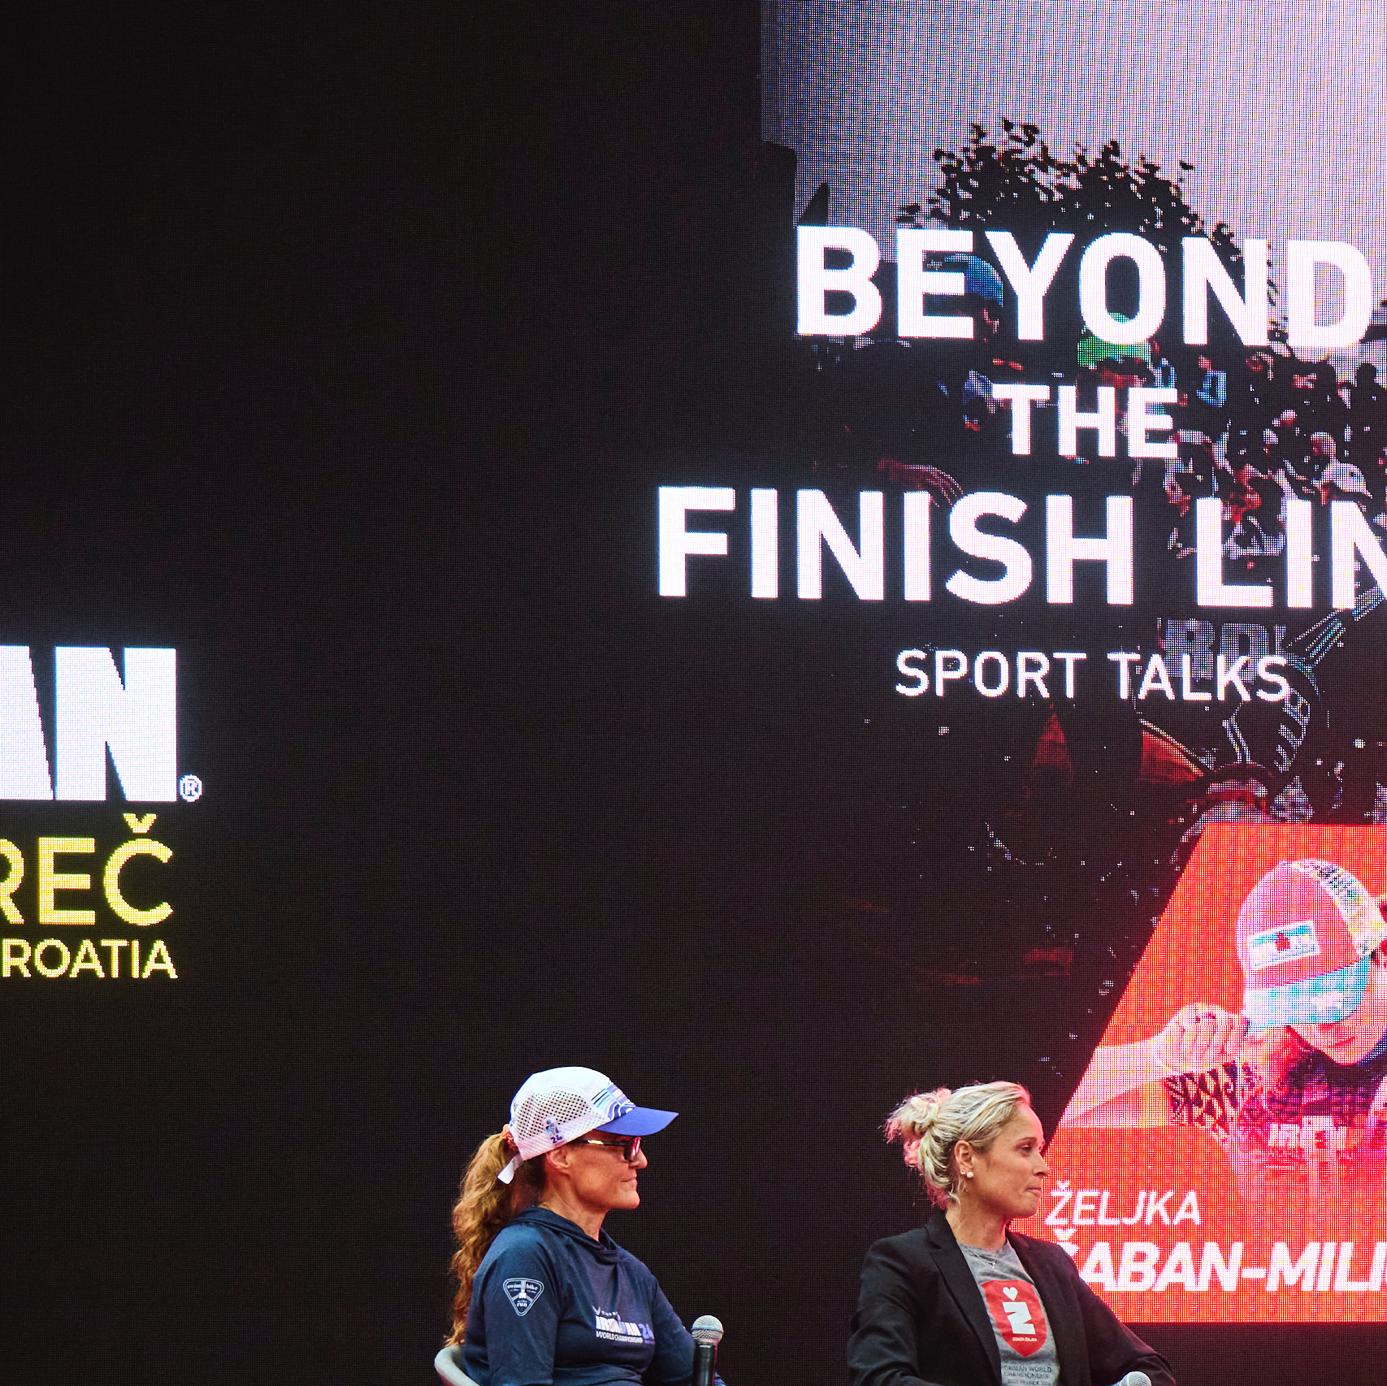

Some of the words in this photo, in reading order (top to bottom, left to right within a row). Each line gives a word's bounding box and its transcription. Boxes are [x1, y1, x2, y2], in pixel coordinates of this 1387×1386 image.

[795, 224, 1374, 349] BEYOND
[992, 384, 1181, 459] THE
[656, 485, 1135, 606] FINISH
[894, 649, 1088, 702] SPORT
[1106, 650, 1292, 703] TALKS
[2, 938, 179, 980] ROATIA
[1044, 1181, 1202, 1227] ŽELJKA
